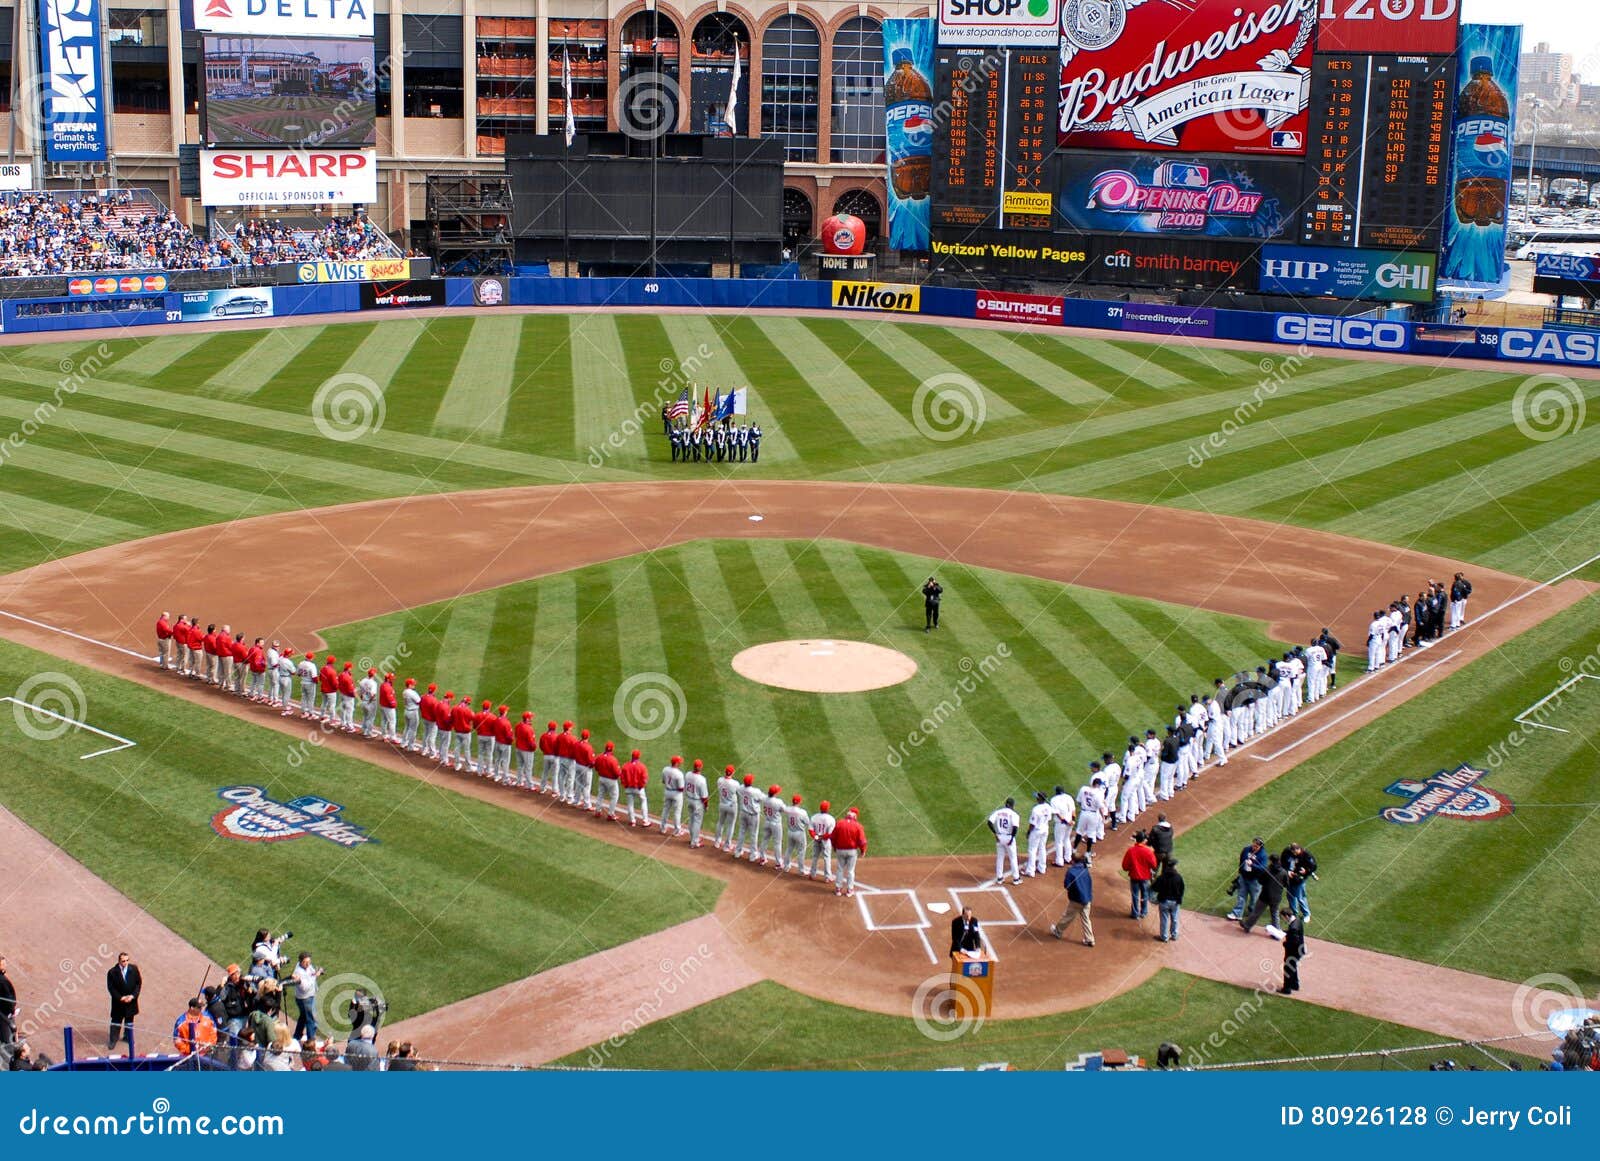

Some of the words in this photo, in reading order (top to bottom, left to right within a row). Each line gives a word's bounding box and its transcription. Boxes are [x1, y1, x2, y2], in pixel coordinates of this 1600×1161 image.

[248, 0, 366, 19] DELTA
[950, 0, 1020, 16] SHOP
[941, 27, 1058, 38] www.stopandshop.com
[1020, 56, 1047, 64] PHILS
[1059, 0, 1311, 132] Budweiser
[1328, 61, 1352, 70] METS
[1036, 73, 1045, 81] SS
[1192, 78, 1208, 90] The
[1211, 75, 1237, 86] Great
[1332, 80, 1337, 88] 7
[1342, 80, 1352, 88] SS
[1434, 80, 1445, 88] 47
[1035, 86, 1044, 94] CF
[1391, 90, 1409, 98] MIL
[1433, 90, 1445, 99] 37
[1333, 93, 1336, 101] 1
[1147, 88, 1233, 129] American
[1239, 83, 1295, 104] Lager
[1391, 101, 1408, 109] STL
[886, 105, 932, 122] PEPSI
[1328, 107, 1334, 116] 5
[1431, 112, 1442, 120] 32
[53, 123, 97, 132] KEYSPAN
[1033, 126, 1043, 134] LF
[1388, 122, 1406, 130] ATL
[1457, 120, 1507, 138] PEPSI
[54, 133, 84, 141] Climate
[87, 133, 94, 141] is
[1388, 132, 1405, 140] COL
[950, 148, 965, 156] SEA
[1337, 149, 1347, 158] LF
[0, 166, 20, 176] ORS
[213, 154, 366, 178] SHARP
[949, 168, 965, 176] CLE
[1385, 174, 1397, 183] SF
[239, 192, 278, 201] OFFICIAL
[283, 191, 324, 200] SPONSOR
[1100, 175, 1208, 210] OPENING
[1212, 181, 1264, 213] DAY
[1005, 195, 1049, 206] Armitron
[1165, 212, 1205, 228] 2008
[932, 242, 985, 257] Verizon
[991, 245, 1039, 259] Yellow
[1042, 247, 1085, 262] Pages
[823, 258, 847, 269] HOME
[853, 258, 868, 269] RUN
[1105, 252, 1130, 268] citi
[1135, 253, 1180, 270] smith
[1184, 255, 1239, 276] barney
[1538, 255, 1582, 271] AZEK
[325, 263, 365, 281] WISE
[370, 262, 404, 279] SNACKS
[1264, 259, 1329, 280] HIP
[1375, 263, 1430, 290] GHI
[644, 284, 659, 293] 410
[375, 294, 408, 305] verizon
[838, 285, 913, 309] Nikon
[987, 300, 1062, 315] SOUTHPOLE
[166, 310, 182, 321] 371
[1107, 308, 1123, 318] 371
[1126, 312, 1209, 326] freecreditreport.com
[1276, 315, 1405, 348] GEICO
[1480, 334, 1498, 344] 358
[999, 818, 1009, 828] 12
